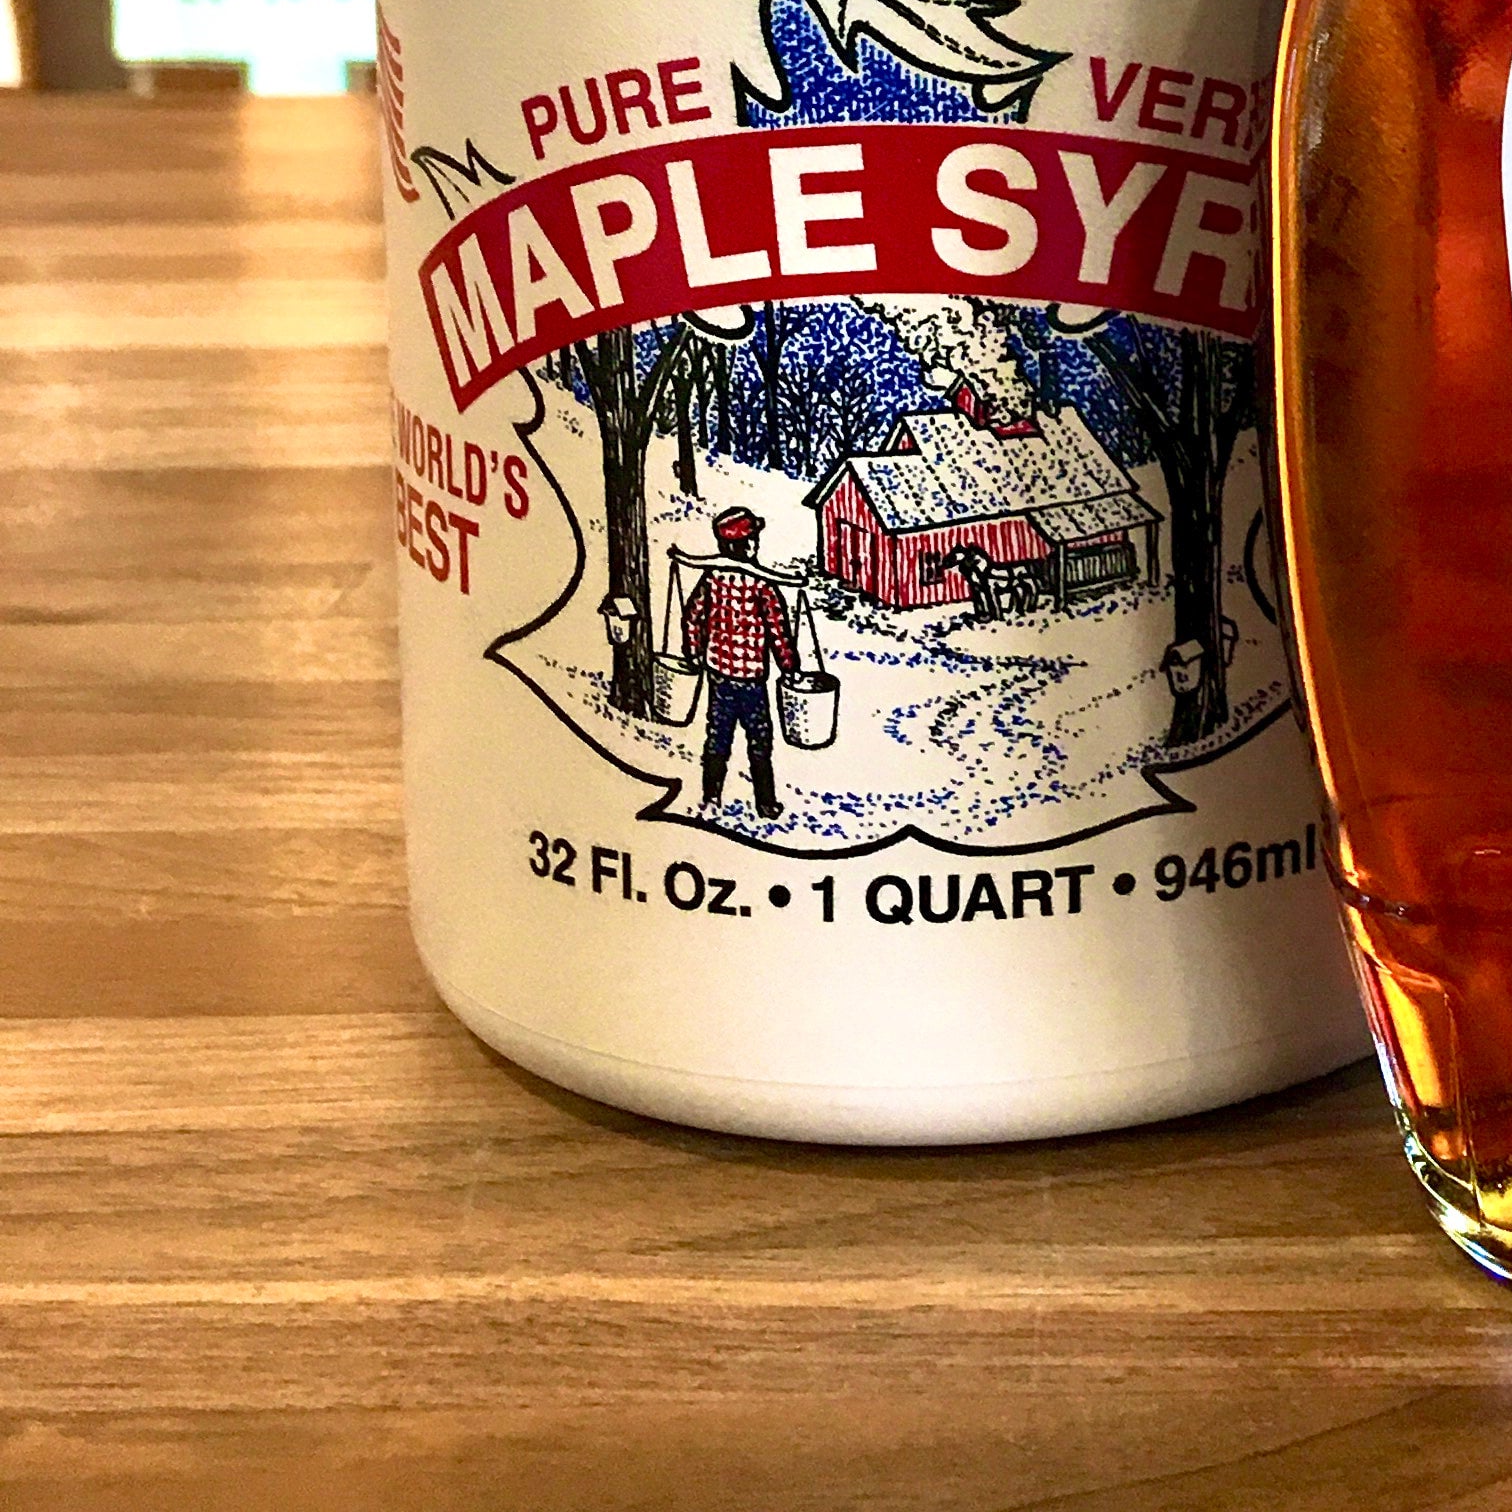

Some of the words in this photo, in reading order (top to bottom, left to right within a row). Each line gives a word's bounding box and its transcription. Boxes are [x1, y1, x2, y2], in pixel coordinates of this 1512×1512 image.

[520, 55, 712, 161] PURE
[1088, 56, 1260, 153] VER
[430, 143, 878, 387] MAPLE
[395, 466, 480, 596] BEST
[528, 830, 578, 887] 32
[590, 844, 648, 904] Fl.
[663, 860, 752, 918] Oz.
[811, 875, 835, 923] 1
[865, 864, 1095, 926] QUART
[1154, 823, 1316, 902] 946ml
